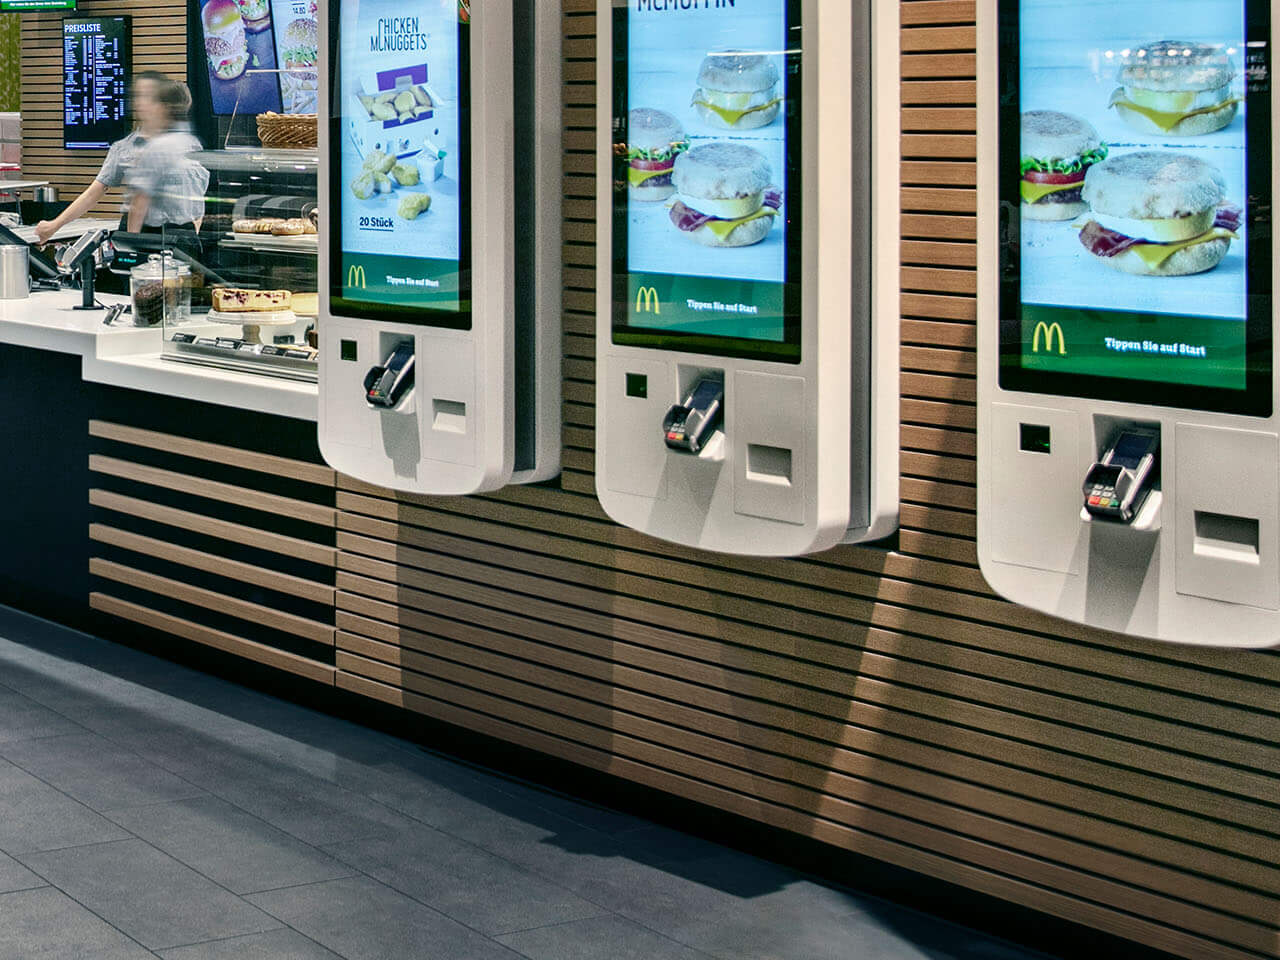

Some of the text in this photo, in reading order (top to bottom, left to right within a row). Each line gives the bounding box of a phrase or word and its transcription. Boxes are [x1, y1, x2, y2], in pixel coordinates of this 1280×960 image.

[64, 23, 101, 33] PREISLISTE
[378, 17, 419, 34] CHICKEN
[359, 216, 394, 228] 20 Stück
[687, 299, 712, 311] Tippen
[739, 304, 758, 315] Start
[1104, 337, 1206, 358] Tippen Sie auf Start
